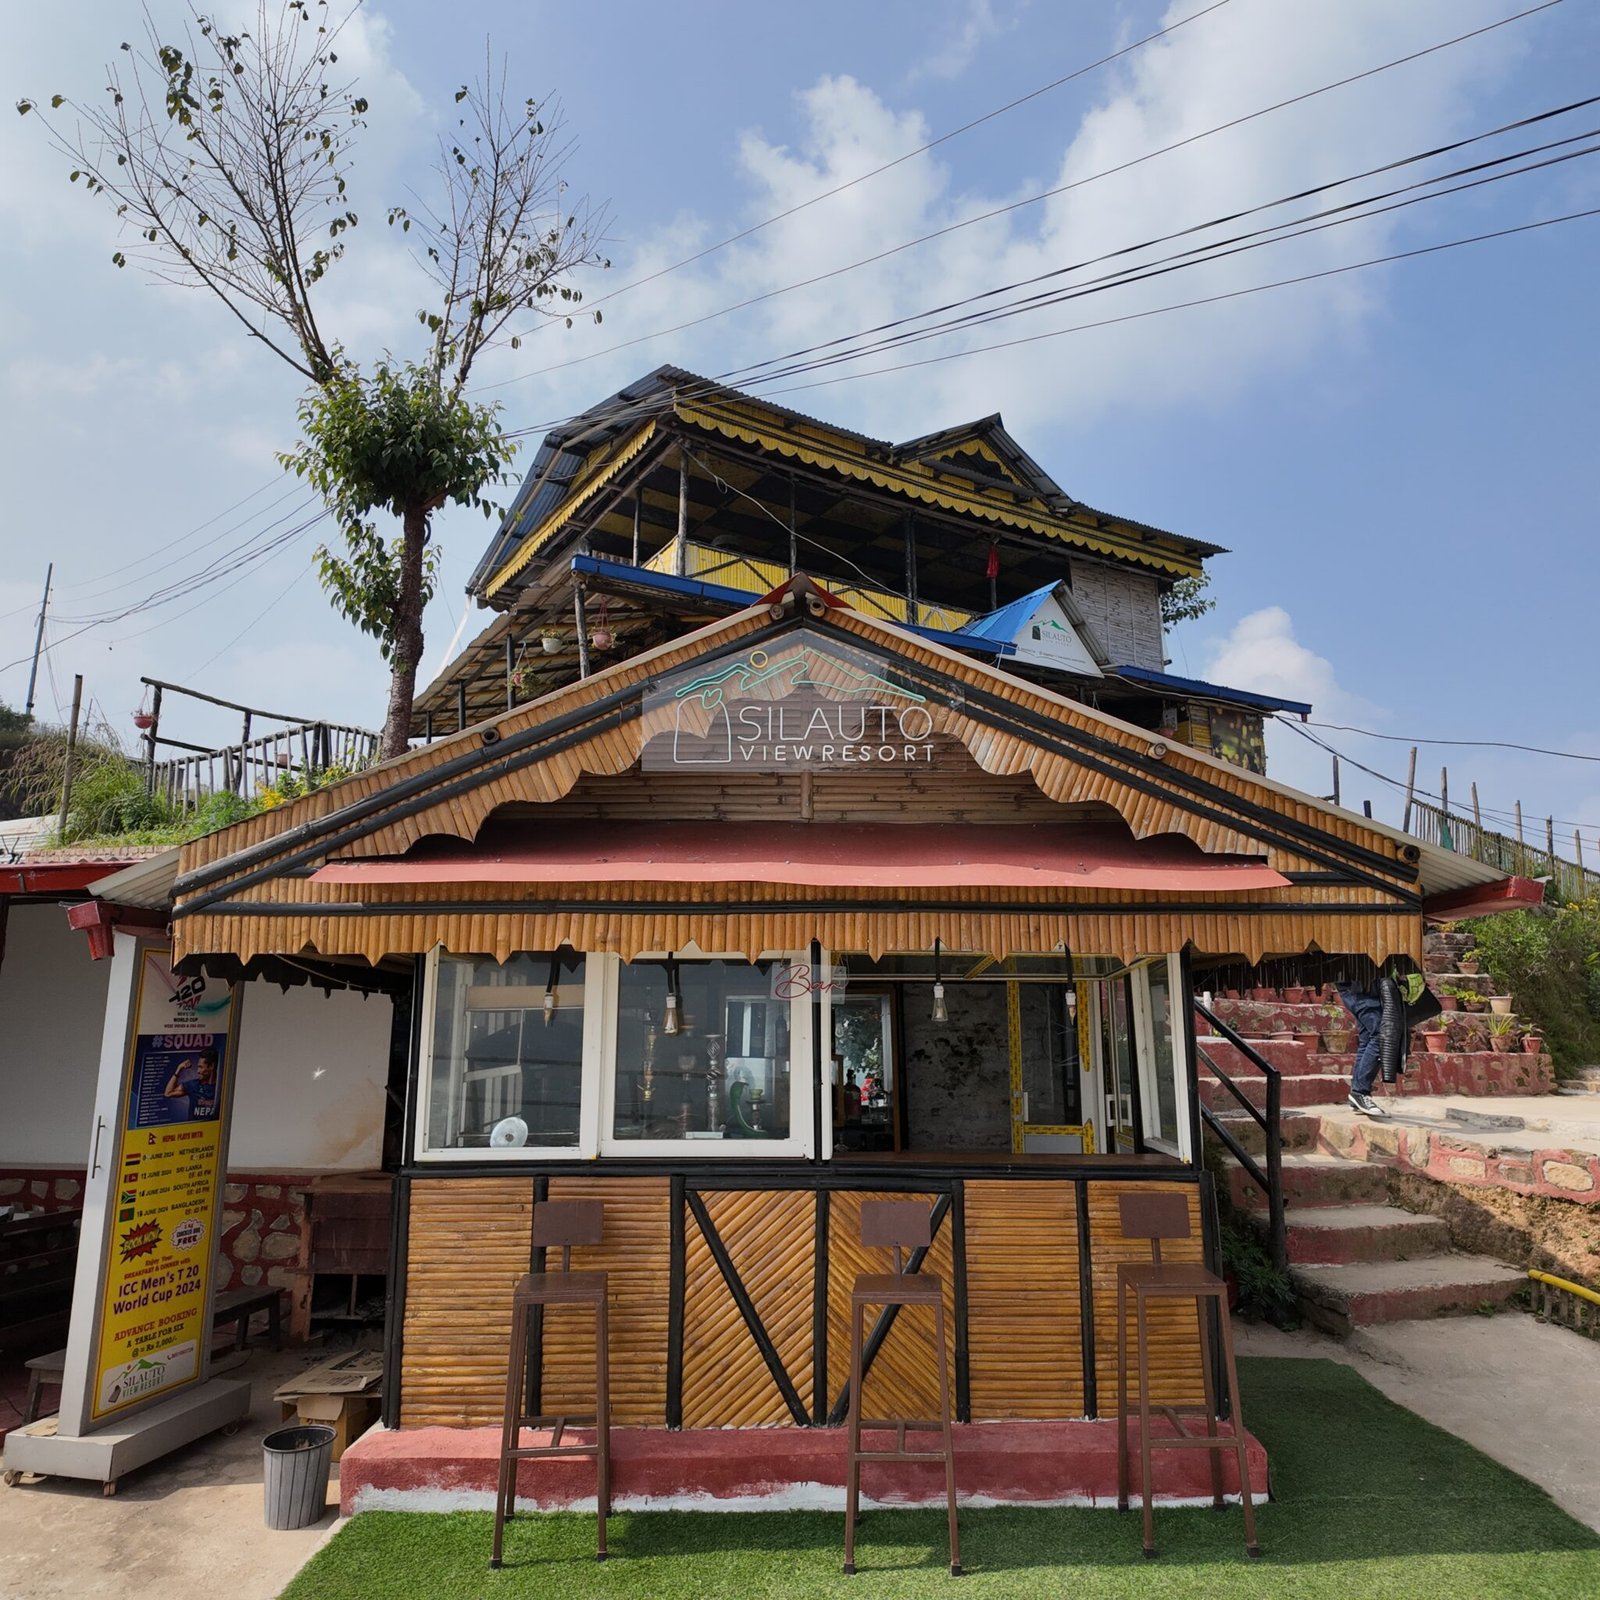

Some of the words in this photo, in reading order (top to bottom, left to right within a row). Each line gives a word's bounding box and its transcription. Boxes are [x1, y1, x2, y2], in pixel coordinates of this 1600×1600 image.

[1042, 631, 1072, 643] SILAUTO
[737, 705, 933, 742] SILAUTO
[775, 963, 844, 999] Bar
[152, 1034, 214, 1049] #SQUAD
[179, 1145, 215, 1155] NETHERLANDS
[171, 1199, 206, 1210] BANGLADESH
[176, 1234, 198, 1246] FREE
[119, 1282, 138, 1298] ICC
[141, 1272, 174, 1292] Men's
[178, 1269, 184, 1280] T
[186, 1264, 199, 1278] 20
[124, 1266, 154, 1280] BREAKFAST
[113, 1293, 148, 1315] World
[152, 1288, 172, 1303] Cup
[176, 1280, 201, 1297] 2024
[114, 1322, 155, 1342] ADVANCE
[158, 1308, 198, 1326] BOOKING
[135, 1332, 157, 1345] TABLE
[158, 1327, 173, 1338] FOR
[173, 1323, 184, 1332] SIX
[122, 1384, 138, 1398] VIEW
[140, 1376, 164, 1390] RESORT
[123, 1366, 166, 1388] SILAUTO
